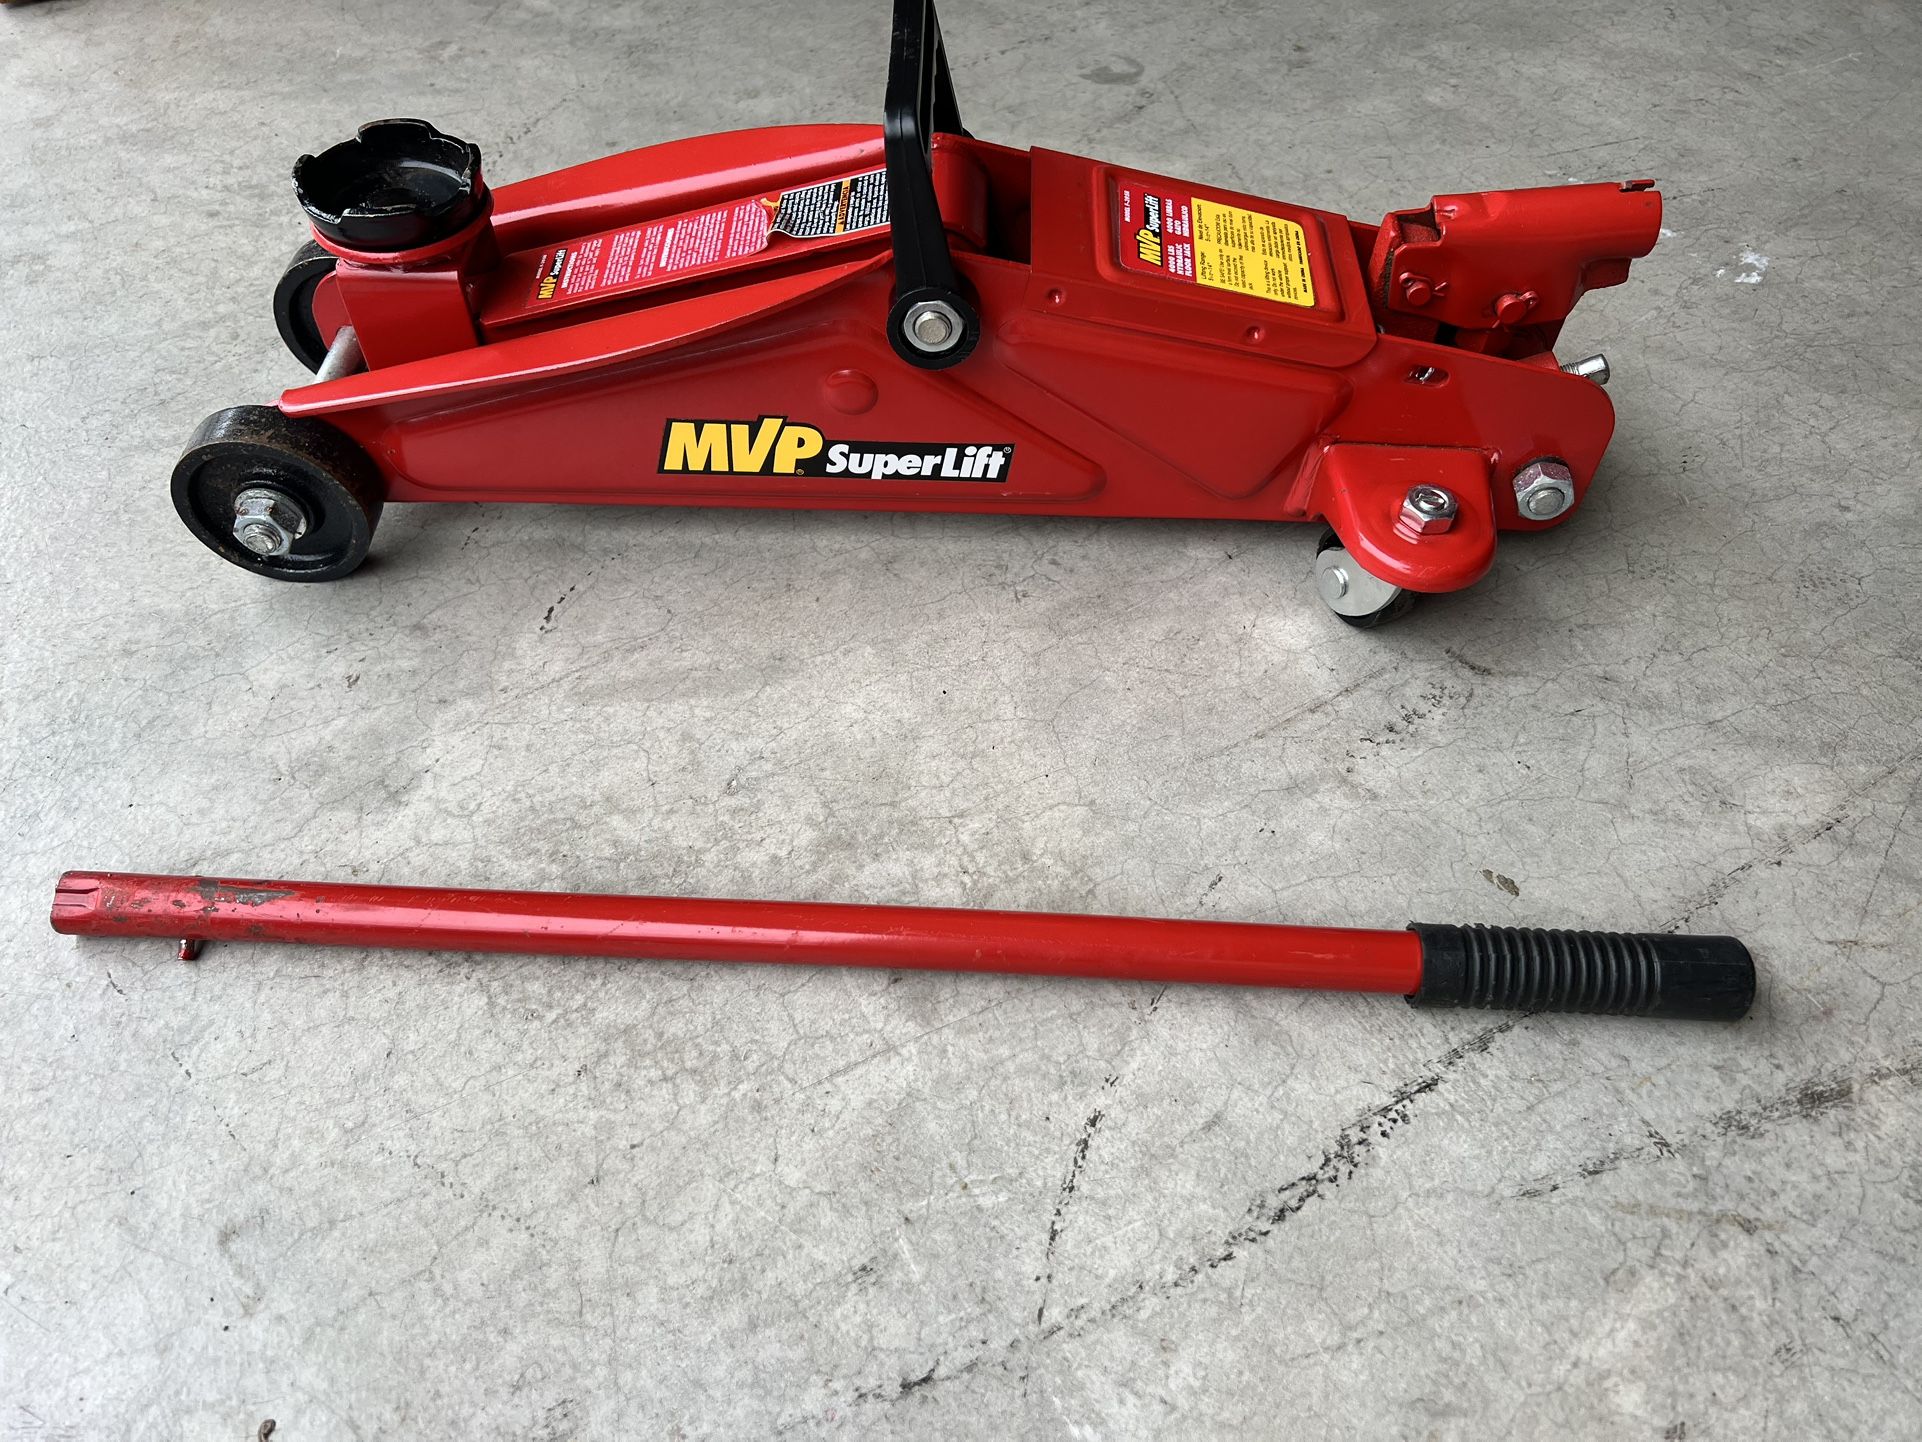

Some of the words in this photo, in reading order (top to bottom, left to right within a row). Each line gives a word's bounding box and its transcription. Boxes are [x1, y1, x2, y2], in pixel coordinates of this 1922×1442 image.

[1145, 195, 1161, 232] SuperLift
[1165, 198, 1173, 217] LIBRAS
[1166, 217, 1174, 234] 4000
[1174, 219, 1182, 235] GATO
[1181, 205, 1190, 238] HIDRAULICO
[1135, 229, 1162, 266] MVP
[1167, 244, 1175, 255] LBS
[1175, 243, 1185, 275] HYDRAULIC
[1183, 243, 1191, 258] JACK
[538, 276, 557, 299] MVP
[550, 249, 567, 275] SuperLift
[561, 251, 578, 288] INSTRUCTIONS
[1167, 256, 1176, 273] 4000
[1184, 258, 1193, 277] FLOOR
[663, 417, 824, 474] MVP
[825, 443, 1006, 480] SuperLift
